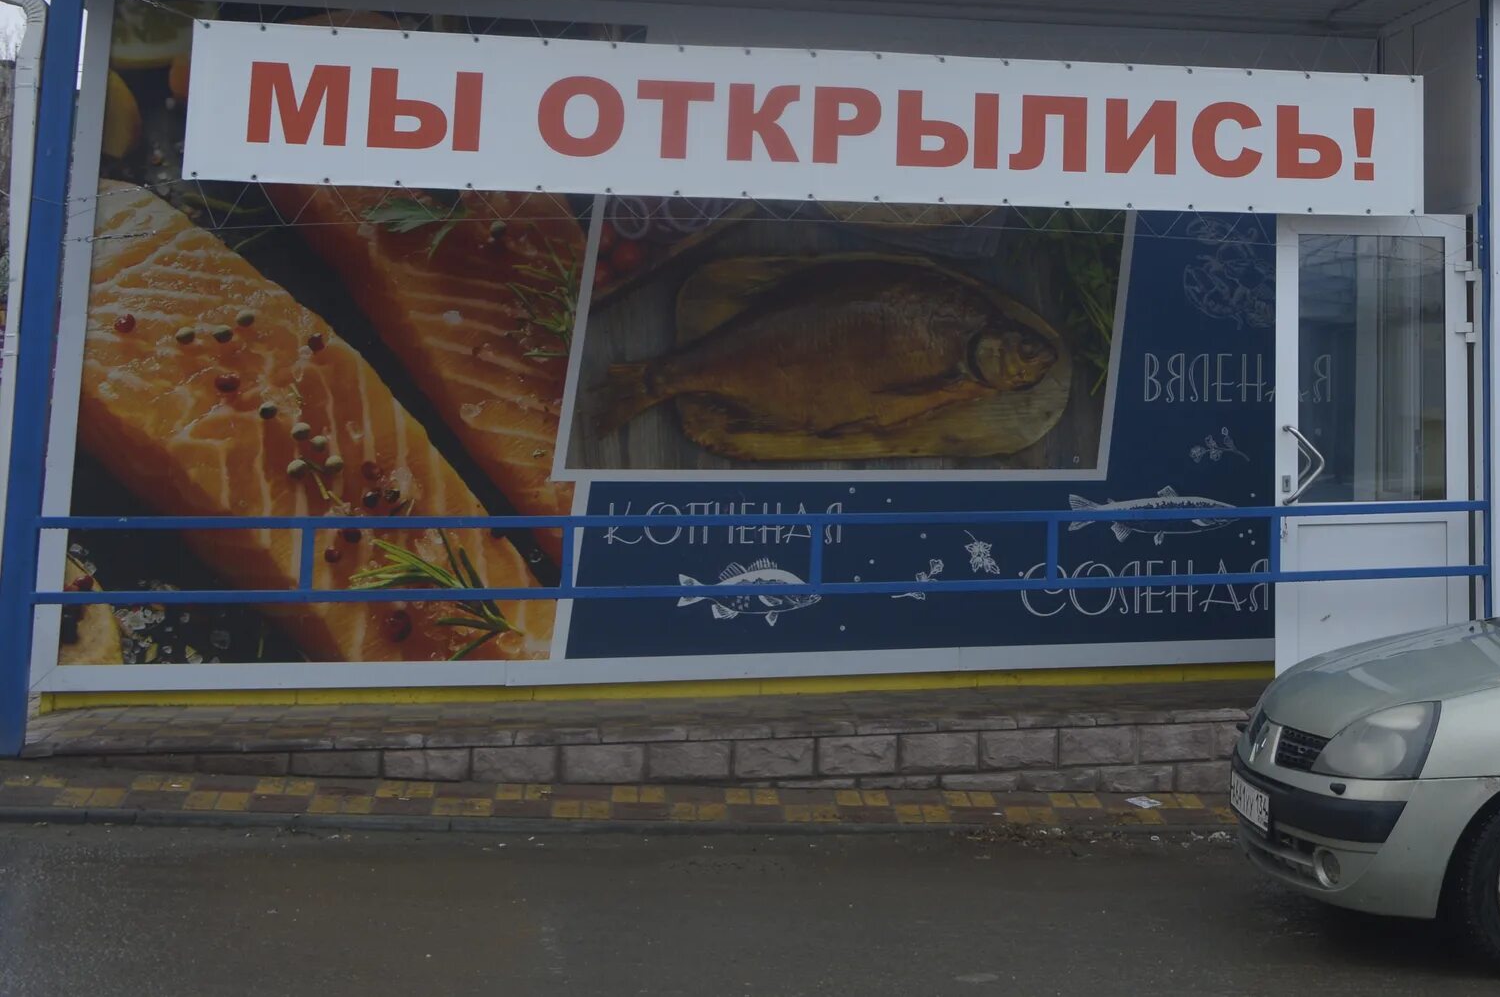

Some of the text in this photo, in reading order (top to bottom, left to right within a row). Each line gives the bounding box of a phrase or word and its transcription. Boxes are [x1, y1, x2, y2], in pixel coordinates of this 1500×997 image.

[246, 60, 1376, 181] МЫ ОТКРЫЛИСЬ!
[1144, 353, 1332, 403] ВЯЛЕНЯ
[603, 501, 843, 545] КОПЧЕНАЯ
[1018, 558, 1270, 617] СОЛЕНАЯ
